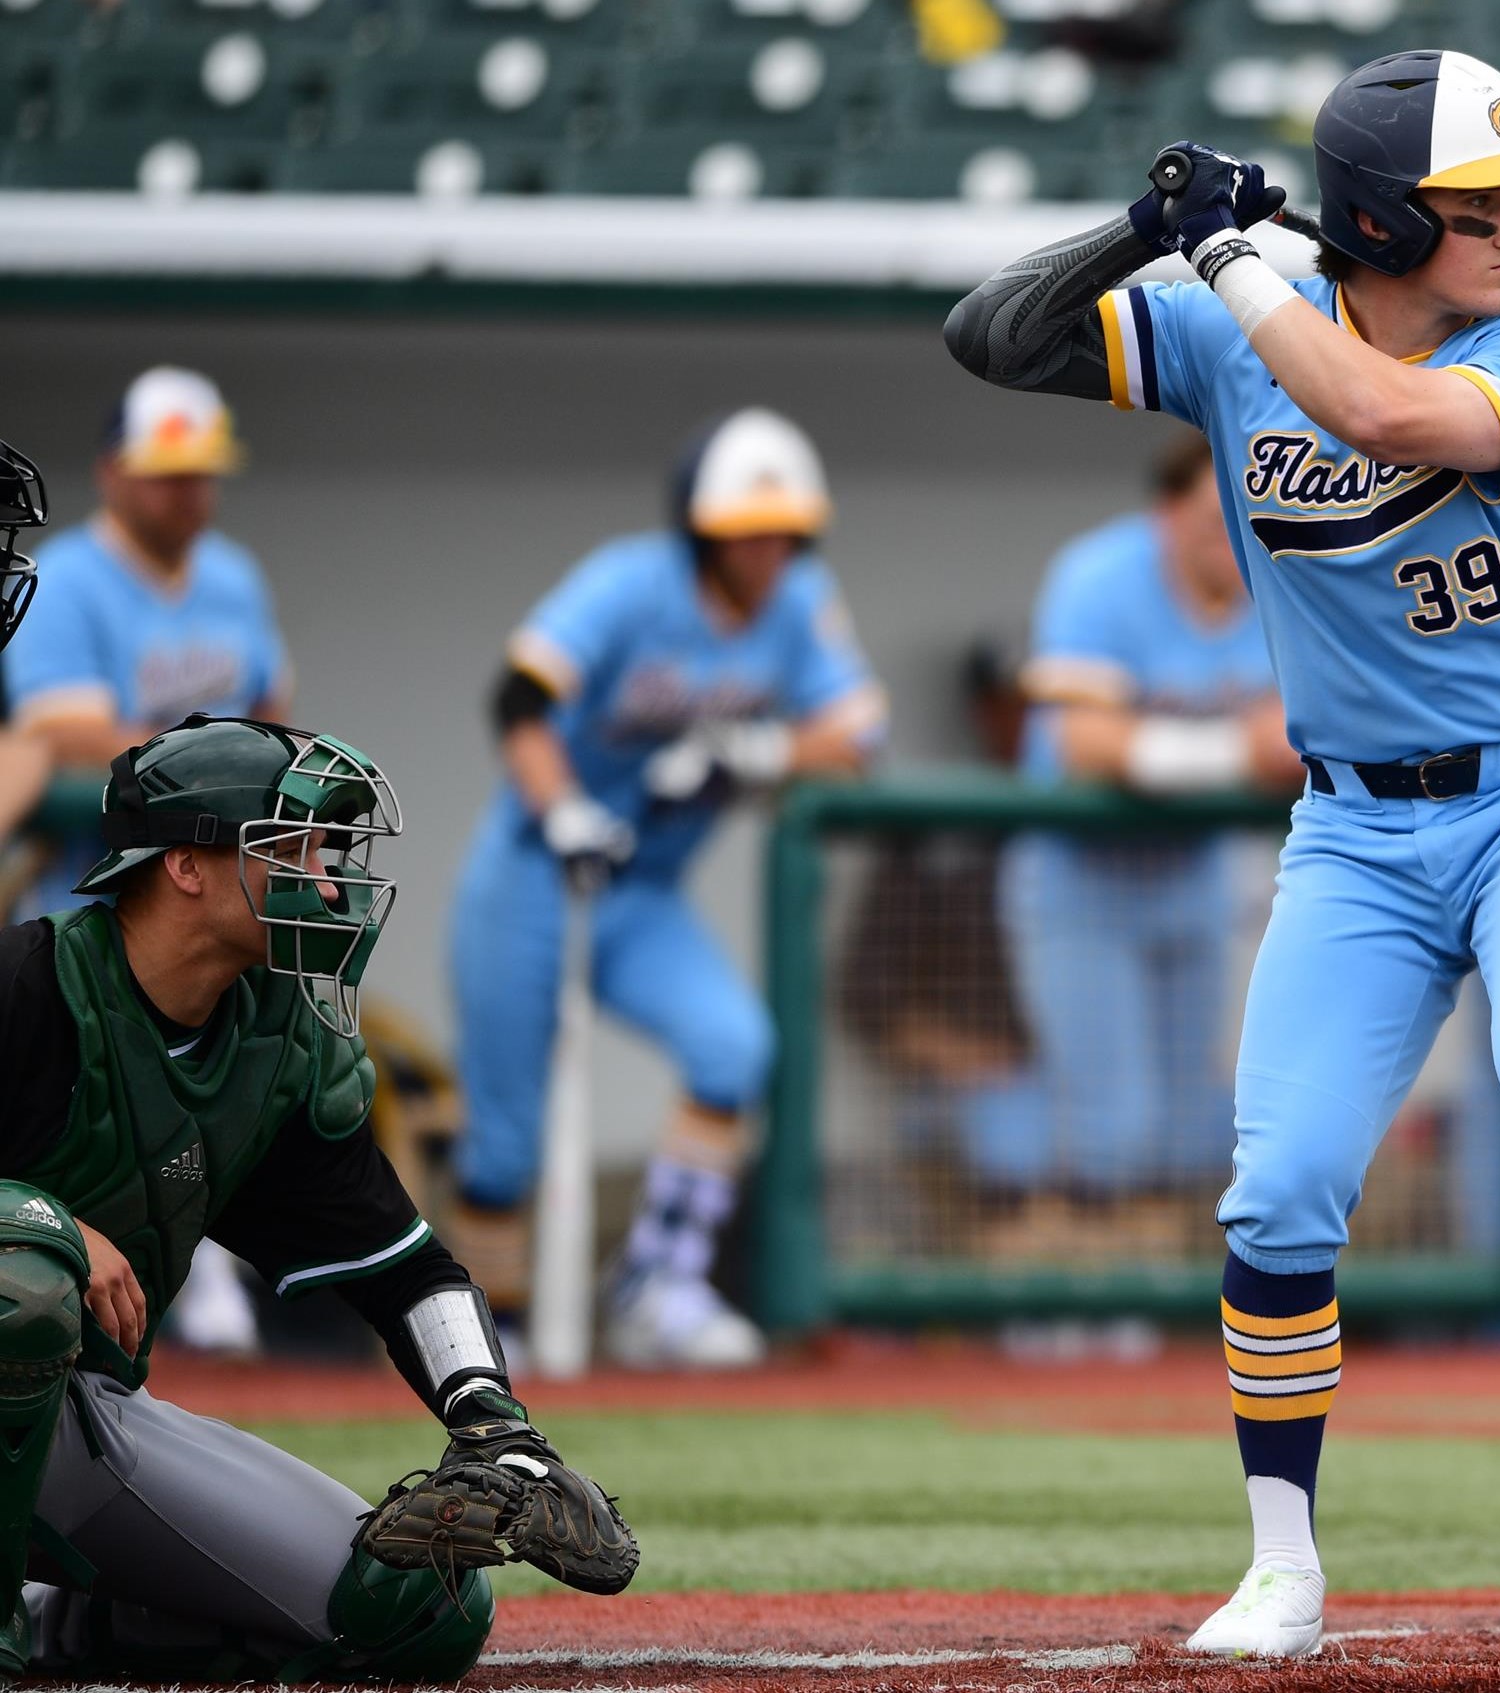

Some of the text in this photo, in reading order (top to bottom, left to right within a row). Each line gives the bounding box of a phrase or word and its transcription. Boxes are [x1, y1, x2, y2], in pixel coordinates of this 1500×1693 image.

[1211, 244, 1229, 255] Life
[1245, 431, 1428, 508] Flase
[160, 1165, 204, 1182] adidas
[16, 1207, 62, 1230] adidas
